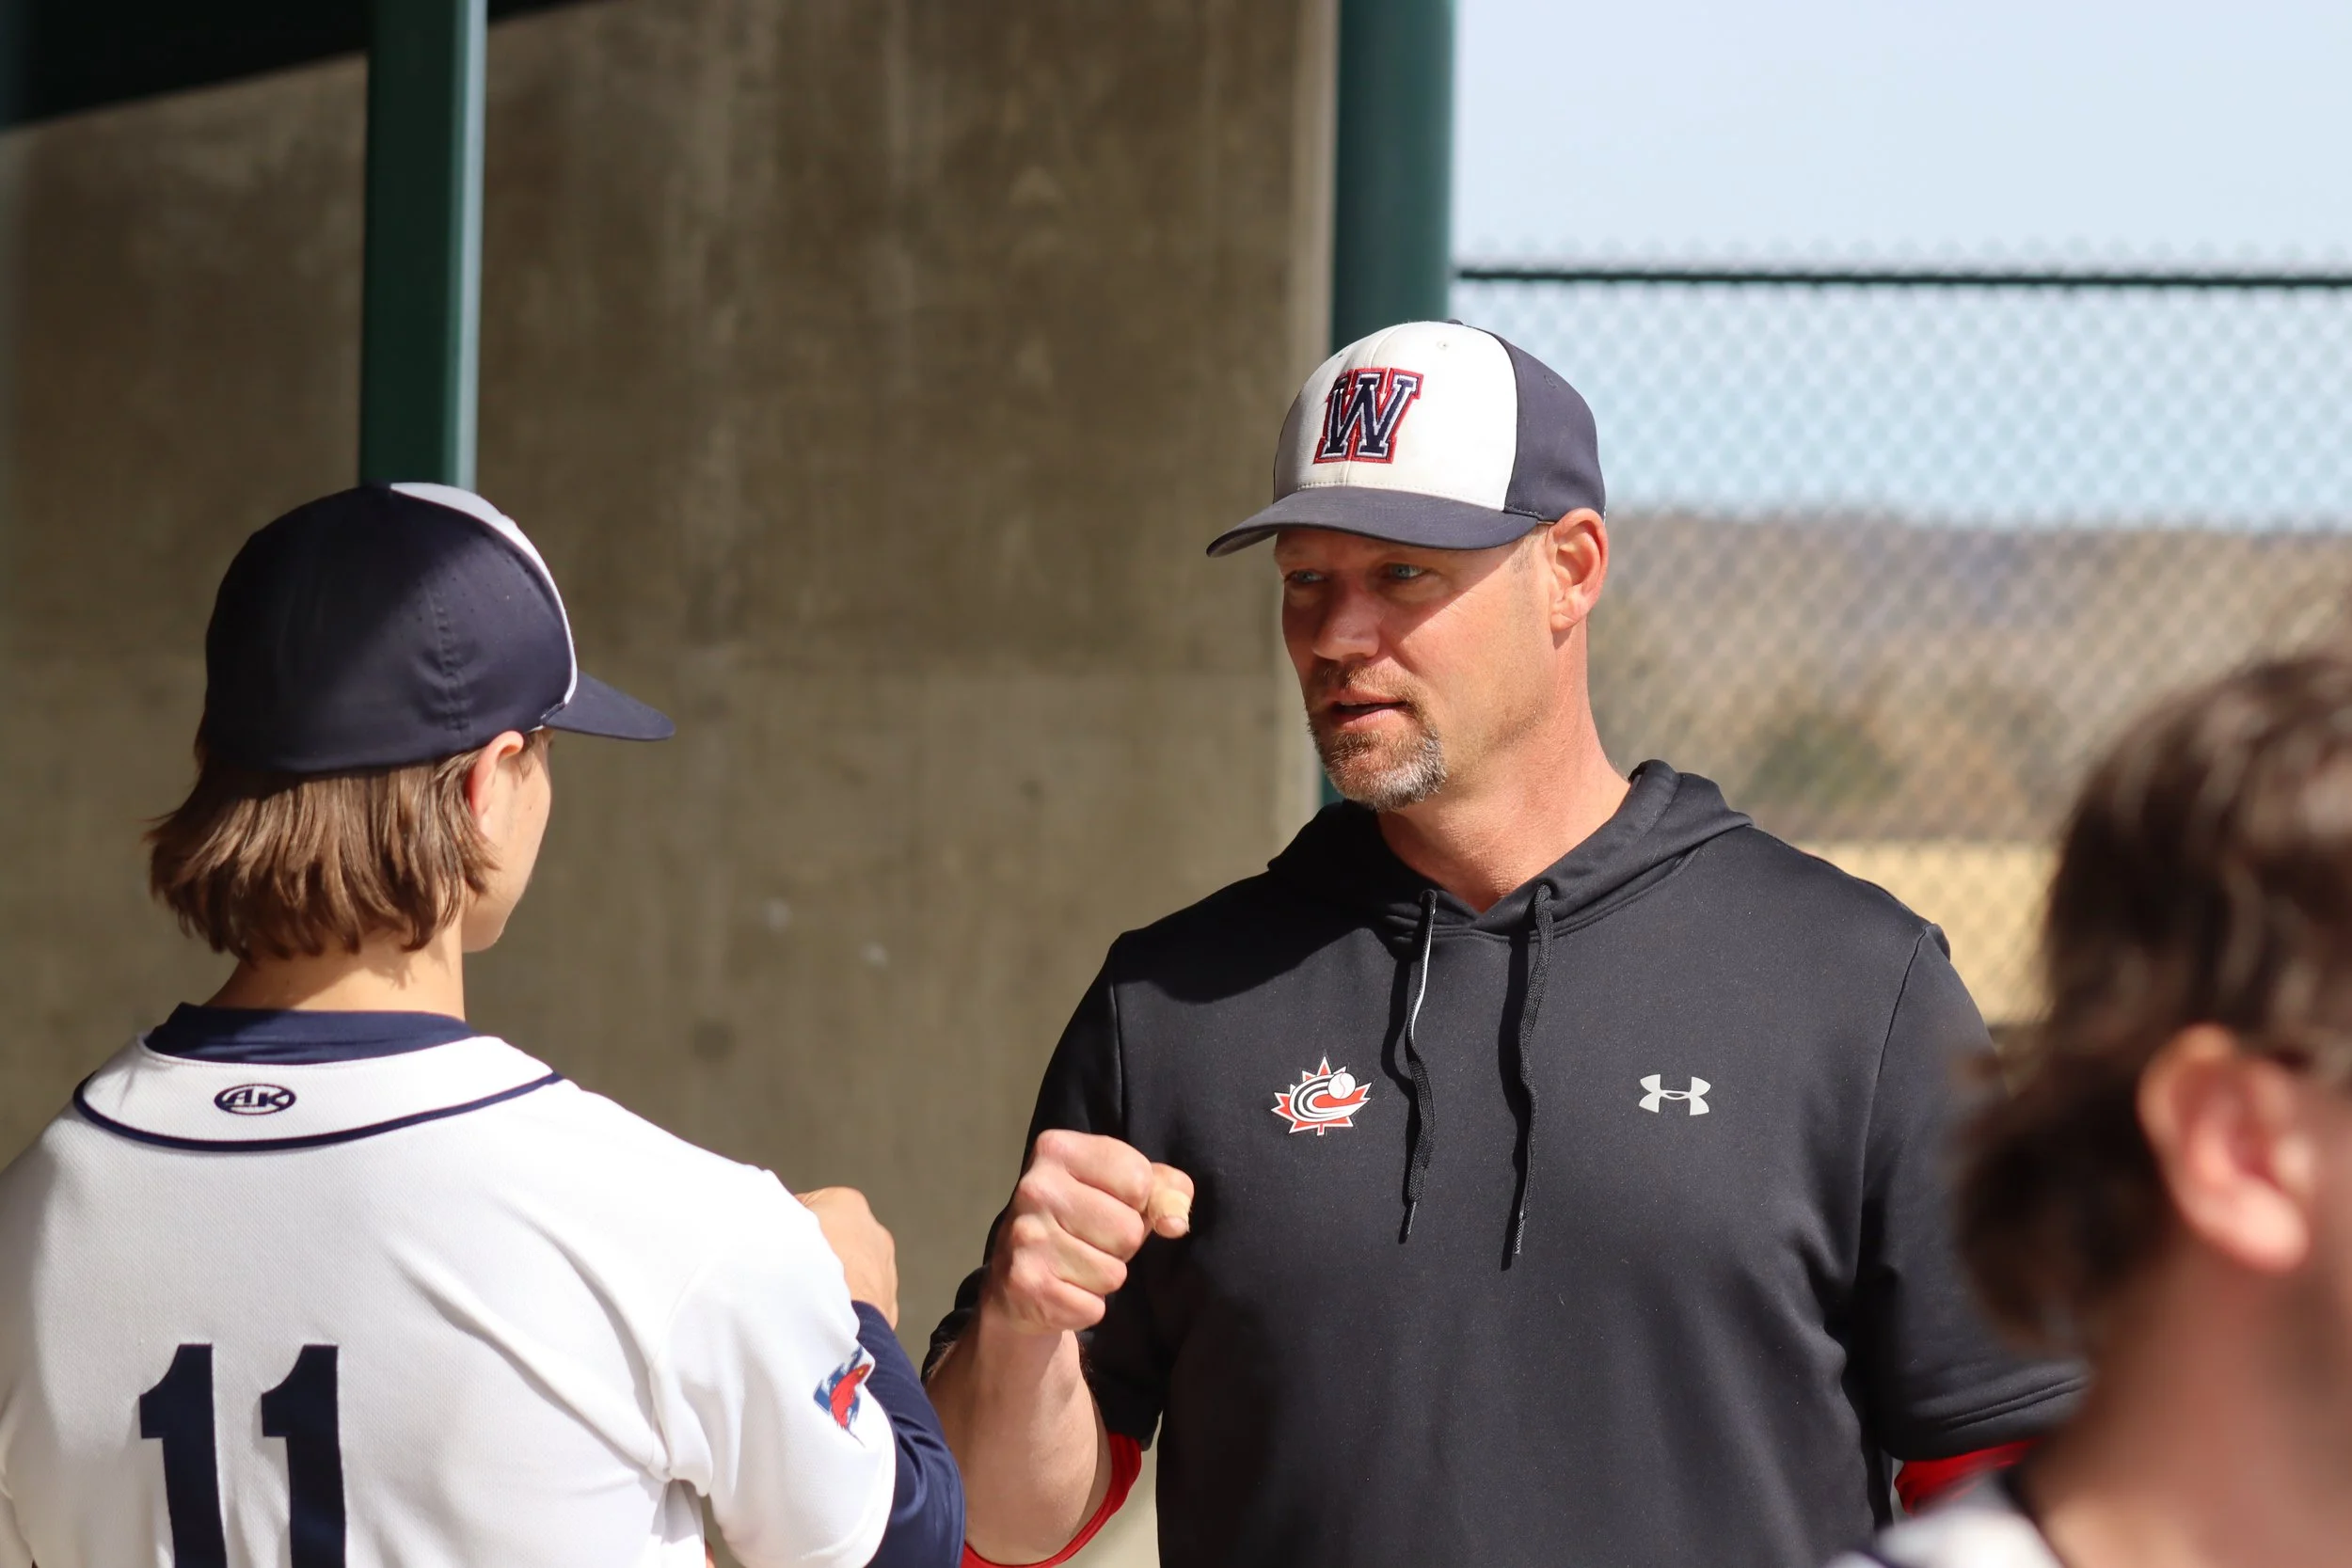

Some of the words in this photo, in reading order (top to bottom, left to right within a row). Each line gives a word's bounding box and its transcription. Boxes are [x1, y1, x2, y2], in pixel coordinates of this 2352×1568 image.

[1313, 367, 1423, 464] W
[222, 1087, 289, 1110] AK
[139, 1343, 346, 1568] 11
